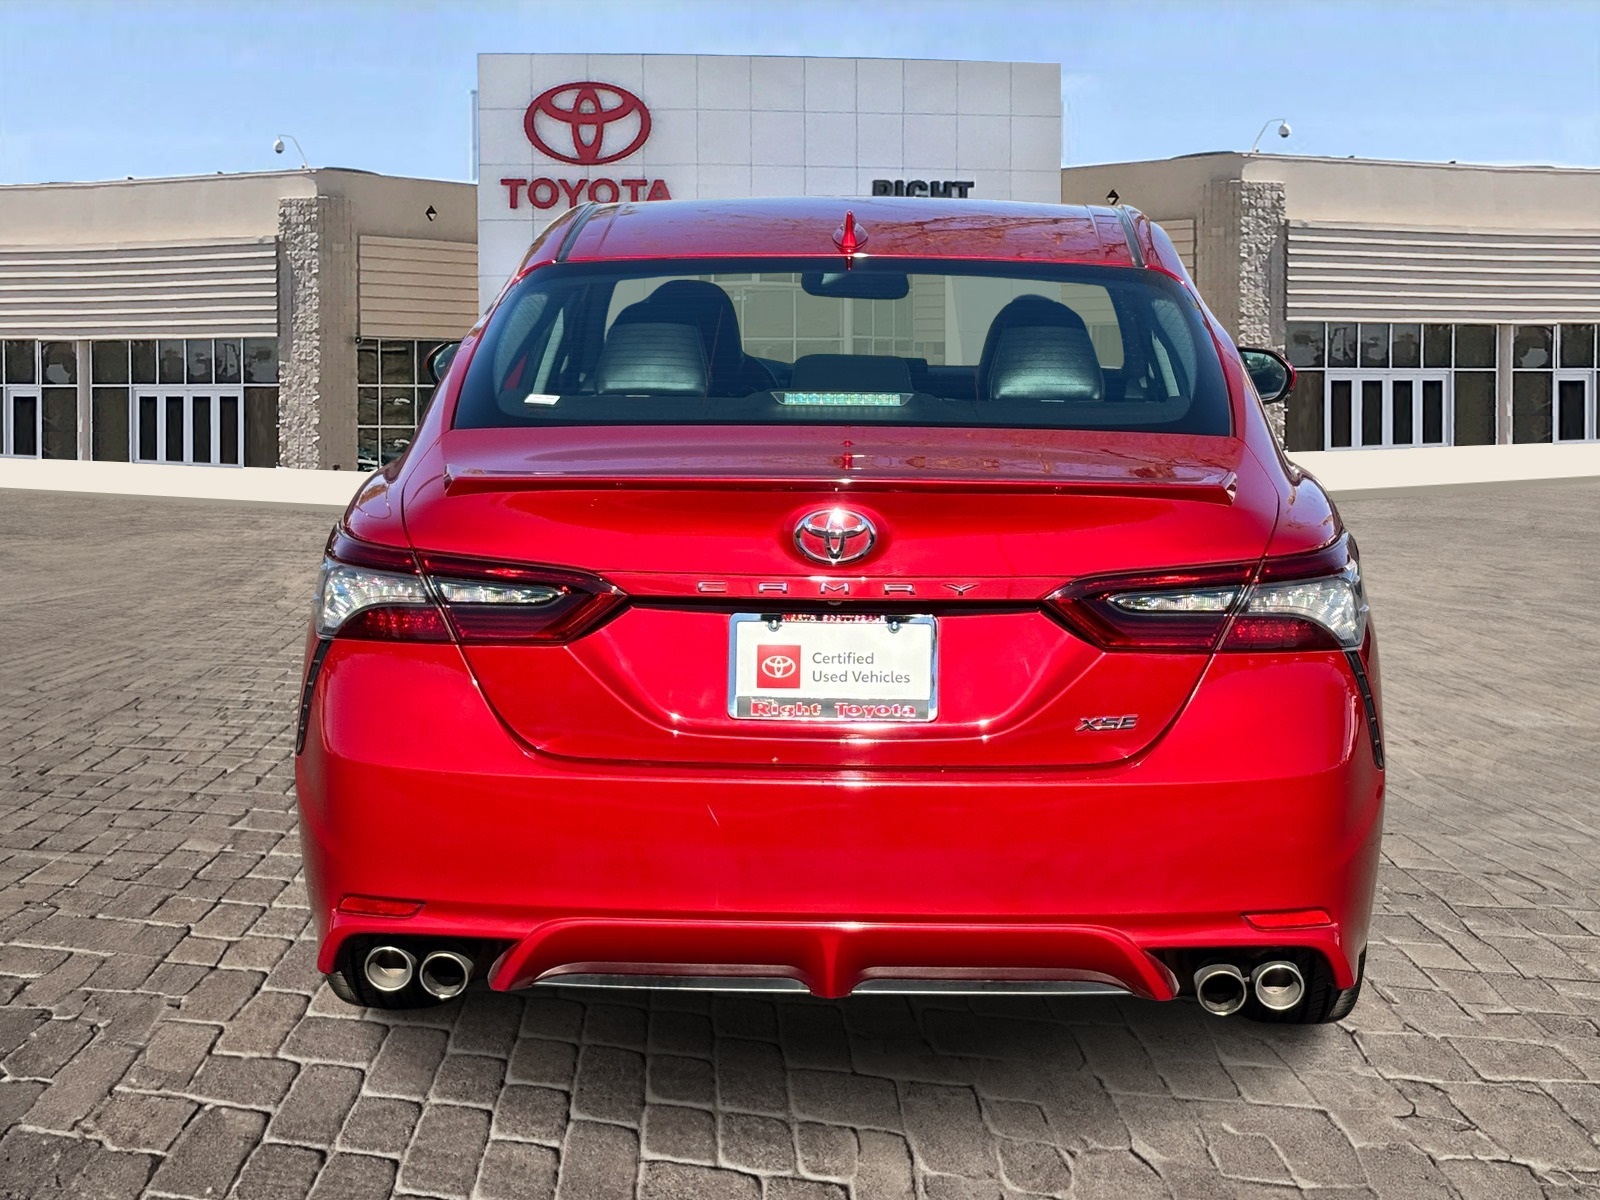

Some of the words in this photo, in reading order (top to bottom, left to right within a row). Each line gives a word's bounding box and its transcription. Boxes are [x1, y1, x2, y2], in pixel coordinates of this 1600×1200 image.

[500, 178, 672, 209] TOYOTA
[697, 581, 979, 596] CAMRY
[812, 652, 875, 665] Certified
[812, 670, 848, 683] Used
[852, 670, 911, 684] Vehicles
[750, 699, 821, 717] Right
[834, 702, 916, 719] Toyota
[1074, 714, 1138, 731] XSE
